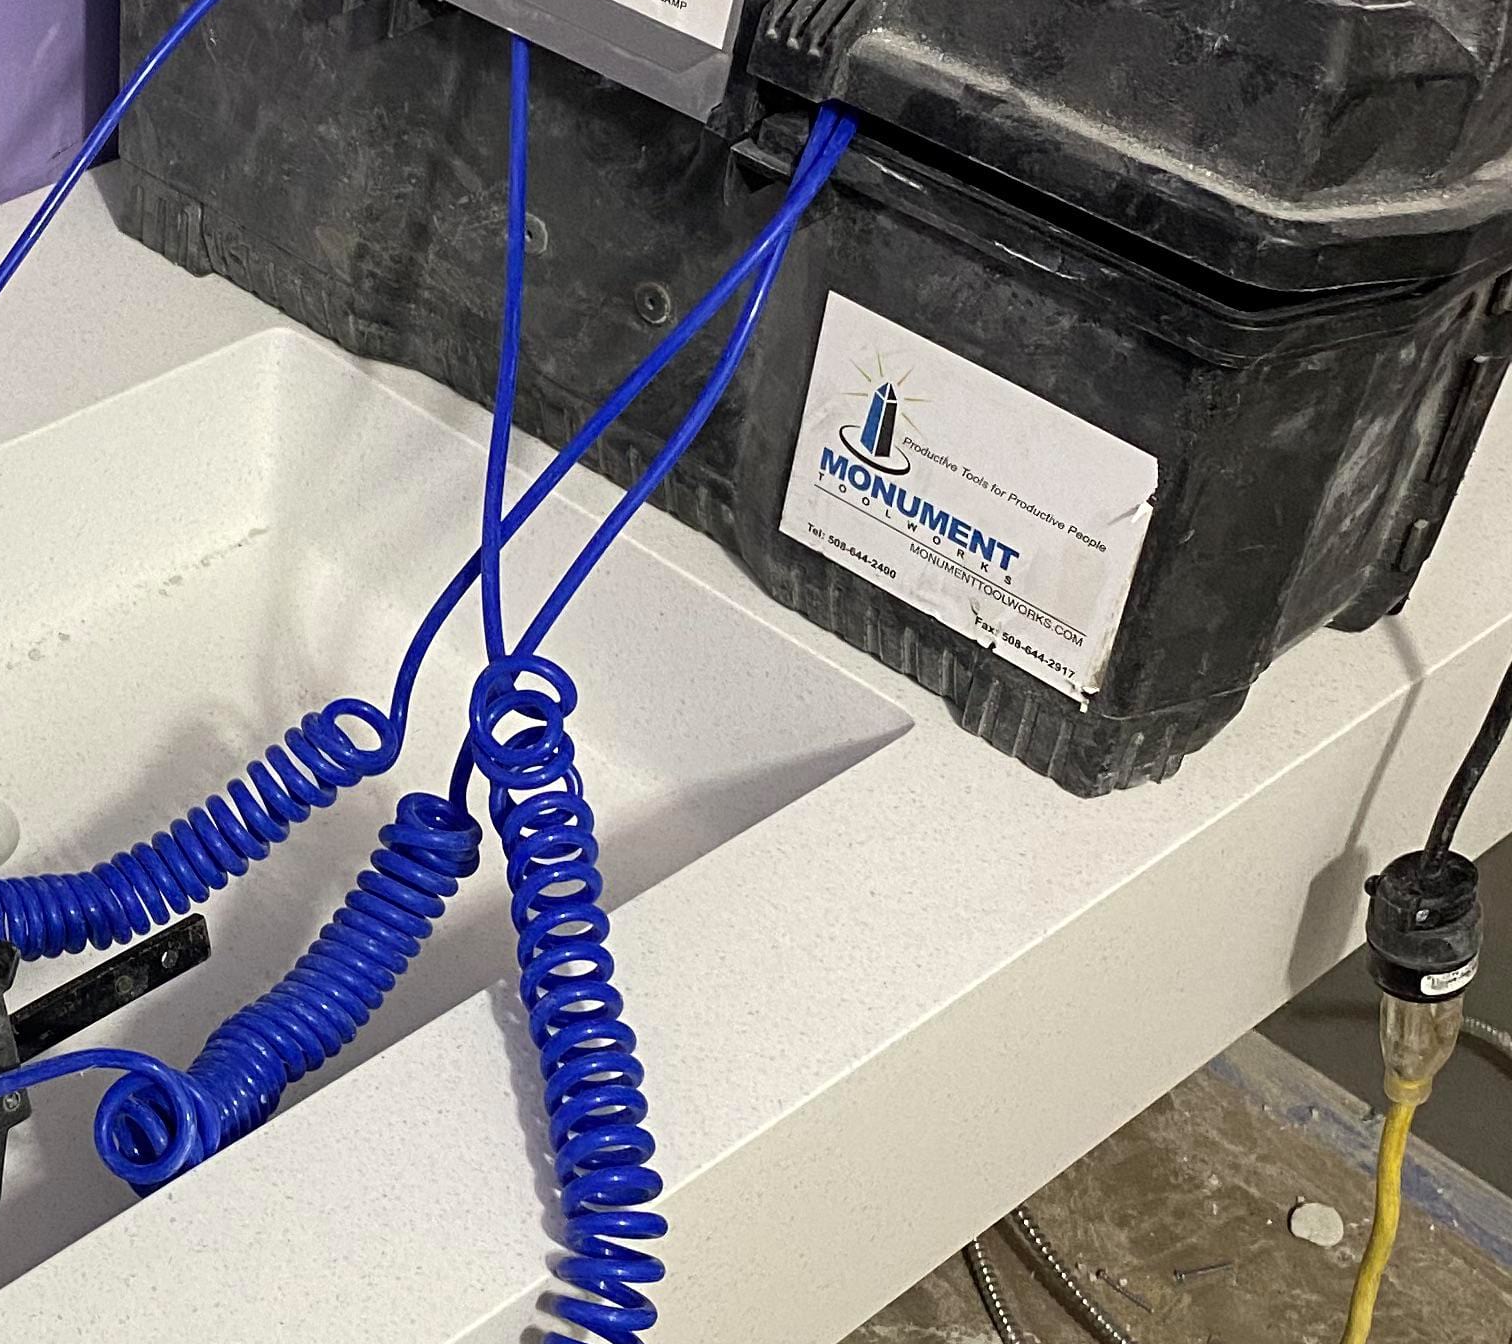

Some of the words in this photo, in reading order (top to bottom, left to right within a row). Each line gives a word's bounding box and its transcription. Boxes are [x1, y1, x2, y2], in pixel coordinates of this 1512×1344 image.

[819, 446, 1020, 573] MONUMENT
[902, 436, 958, 473] Productive
[961, 468, 988, 490] Tools
[990, 482, 1006, 499] for
[1008, 492, 1065, 531] Productive
[1067, 524, 1107, 554] People
[909, 542, 1084, 648] MONUMENTTOOLWORKS.COM
[1002, 631, 1076, 679] 508-644-2917
